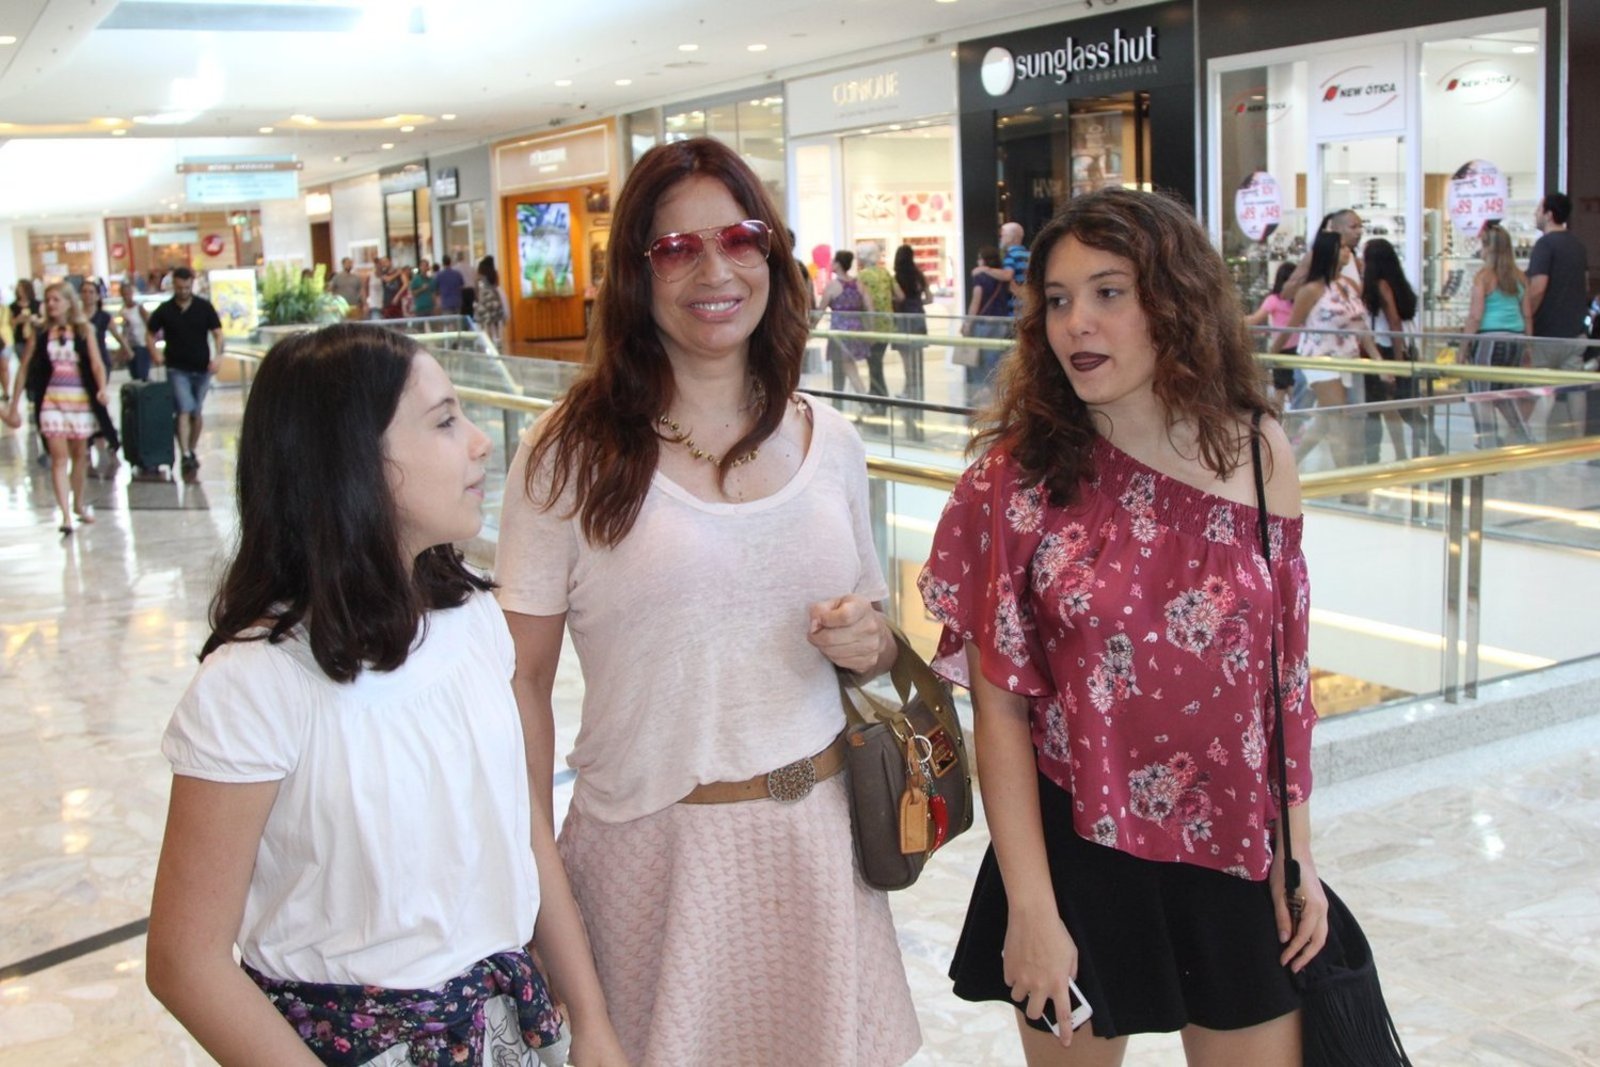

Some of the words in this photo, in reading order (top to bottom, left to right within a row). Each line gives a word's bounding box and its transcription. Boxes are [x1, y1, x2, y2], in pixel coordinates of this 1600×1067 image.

[1015, 36, 1110, 84] sunglass
[1114, 26, 1157, 65] hut
[1340, 87, 1362, 98] NEW
